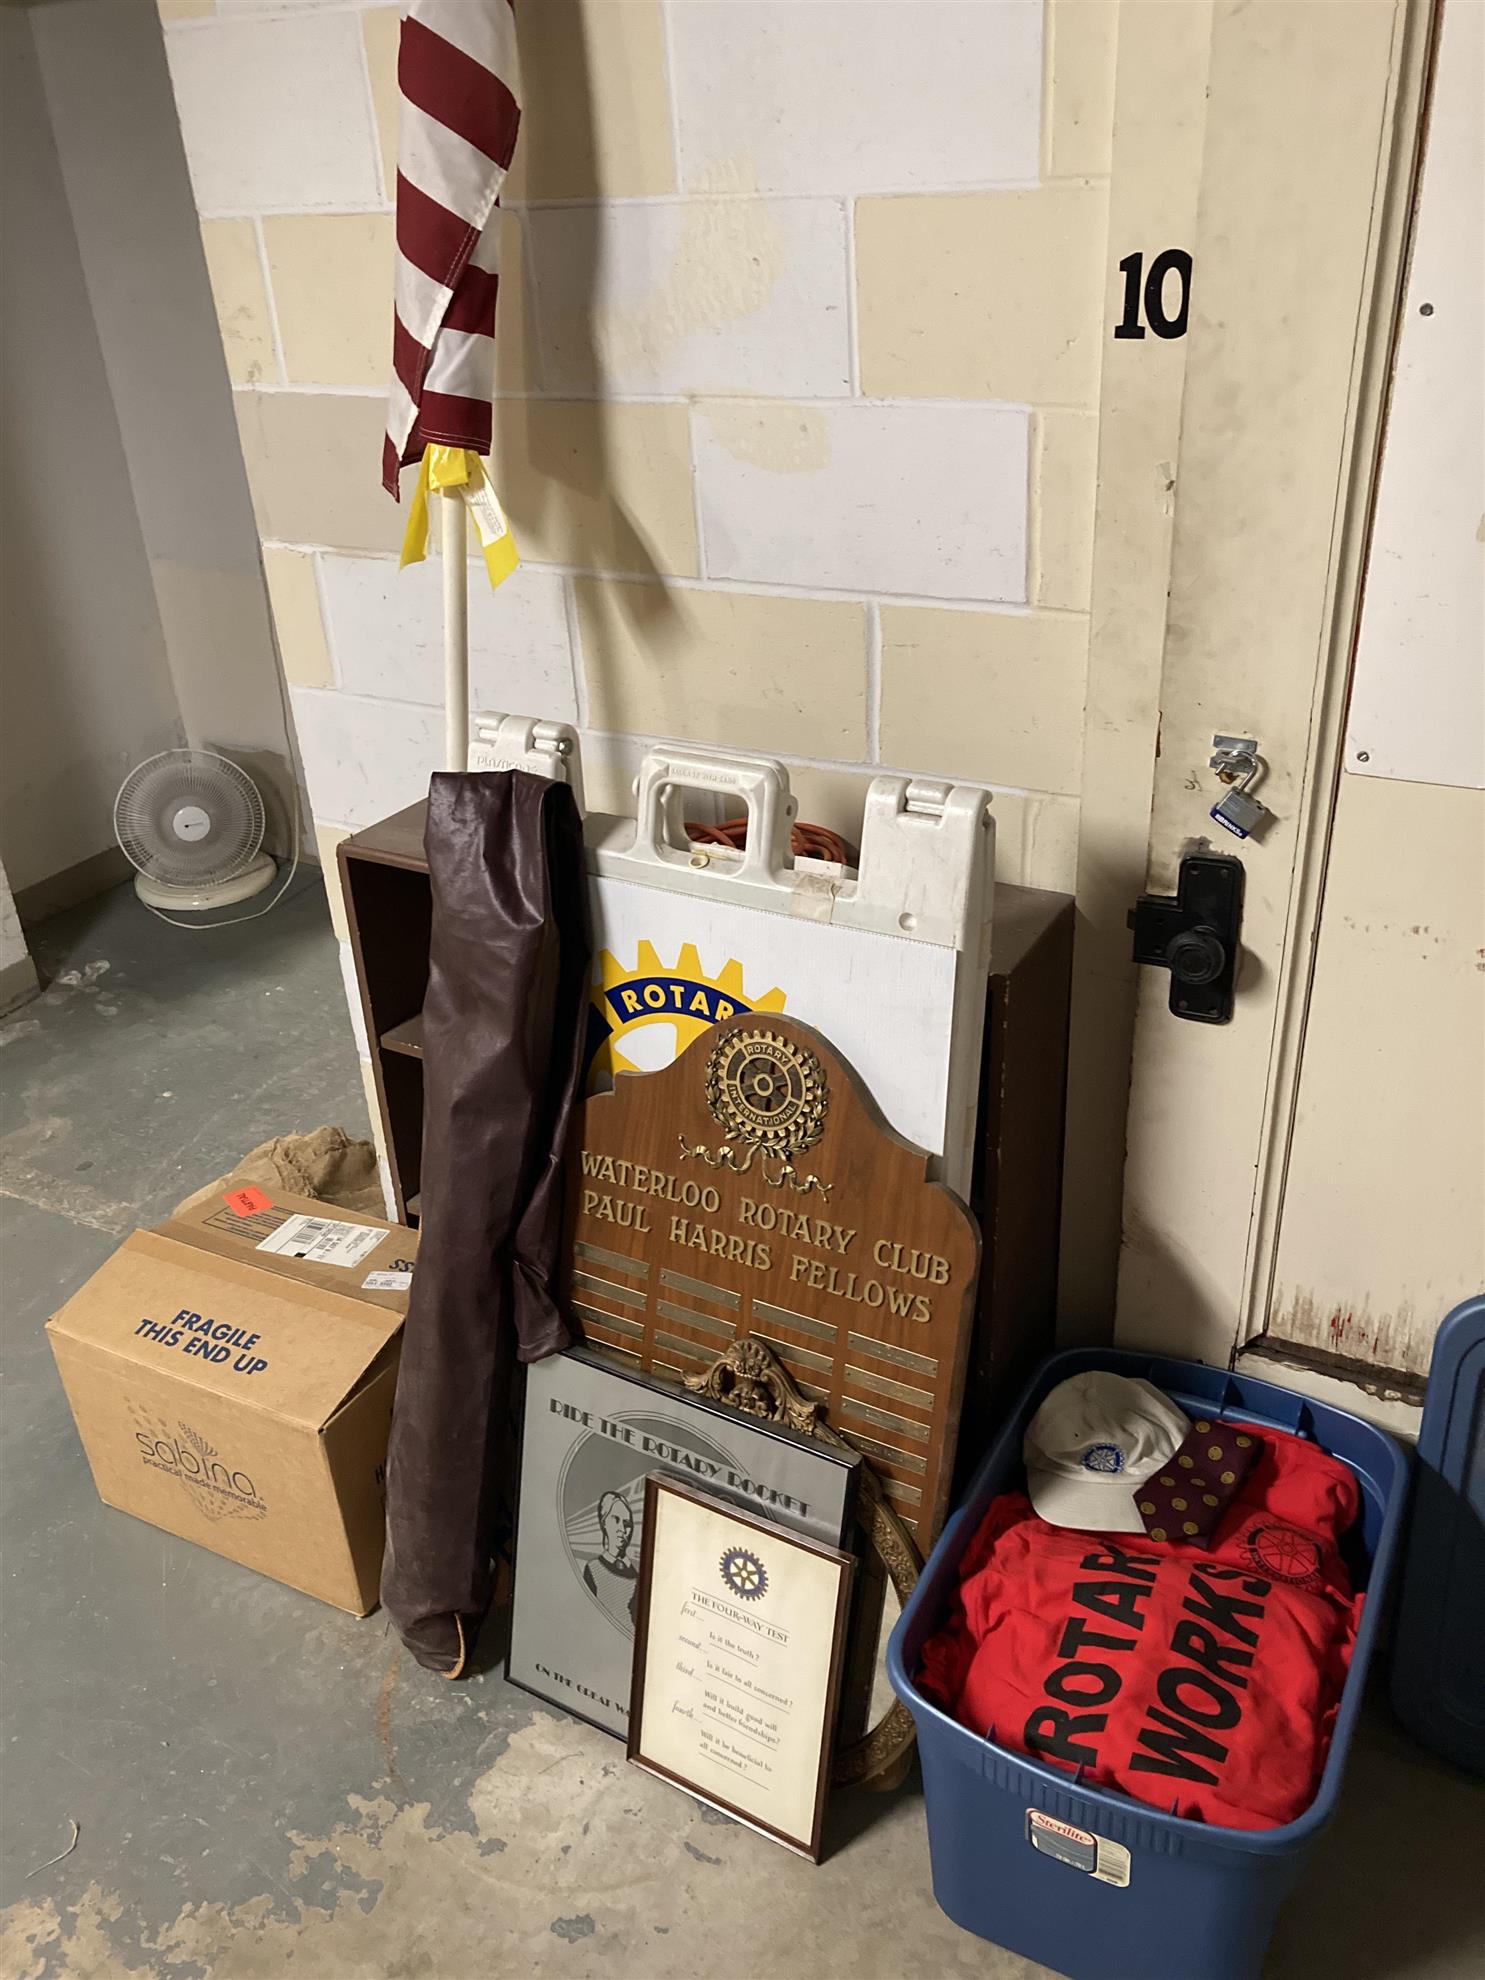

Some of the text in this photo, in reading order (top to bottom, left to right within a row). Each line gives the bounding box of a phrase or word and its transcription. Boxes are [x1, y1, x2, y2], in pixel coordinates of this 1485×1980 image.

[1114, 249, 1193, 339] 10
[620, 984, 734, 1020] ROTAR
[746, 1045, 789, 1065] ROTARY
[729, 1083, 798, 1126] INTERNATIONAL
[580, 1151, 951, 1286] WATERLOO ROTARY CLUB
[583, 1189, 652, 1233] PAUL
[669, 1215, 773, 1271] HARRIS
[790, 1255, 932, 1323] FELLOWS
[134, 1318, 268, 1375] THIS END UP
[171, 1309, 262, 1350] FRAGILE
[550, 1397, 812, 1518] RIDE THE ROTARY ROCKET
[184, 1473, 211, 1489] made
[213, 1485, 267, 1511] memorable
[692, 1592, 789, 1644] THE FOUR-WAY TEST
[709, 1631, 716, 1639] Is
[718, 1634, 723, 1643] it
[725, 1638, 736, 1649] the
[1024, 1543, 1161, 1769] ROTAR
[536, 1663, 550, 1677] ON
[554, 1672, 573, 1688] THE
[577, 1684, 610, 1707] GREAT
[706, 1660, 714, 1669] Is
[715, 1663, 720, 1671] it
[722, 1667, 733, 1678] fair
[735, 1674, 742, 1683] to
[743, 1680, 752, 1689] all
[1128, 1562, 1272, 1787] WORKS
[703, 1702, 716, 1714] and
[718, 1706, 737, 1723] better
[704, 1690, 778, 1732] Will it build good will
[699, 1742, 708, 1751] all
[700, 1729, 773, 1772] Will it be beneficial to
